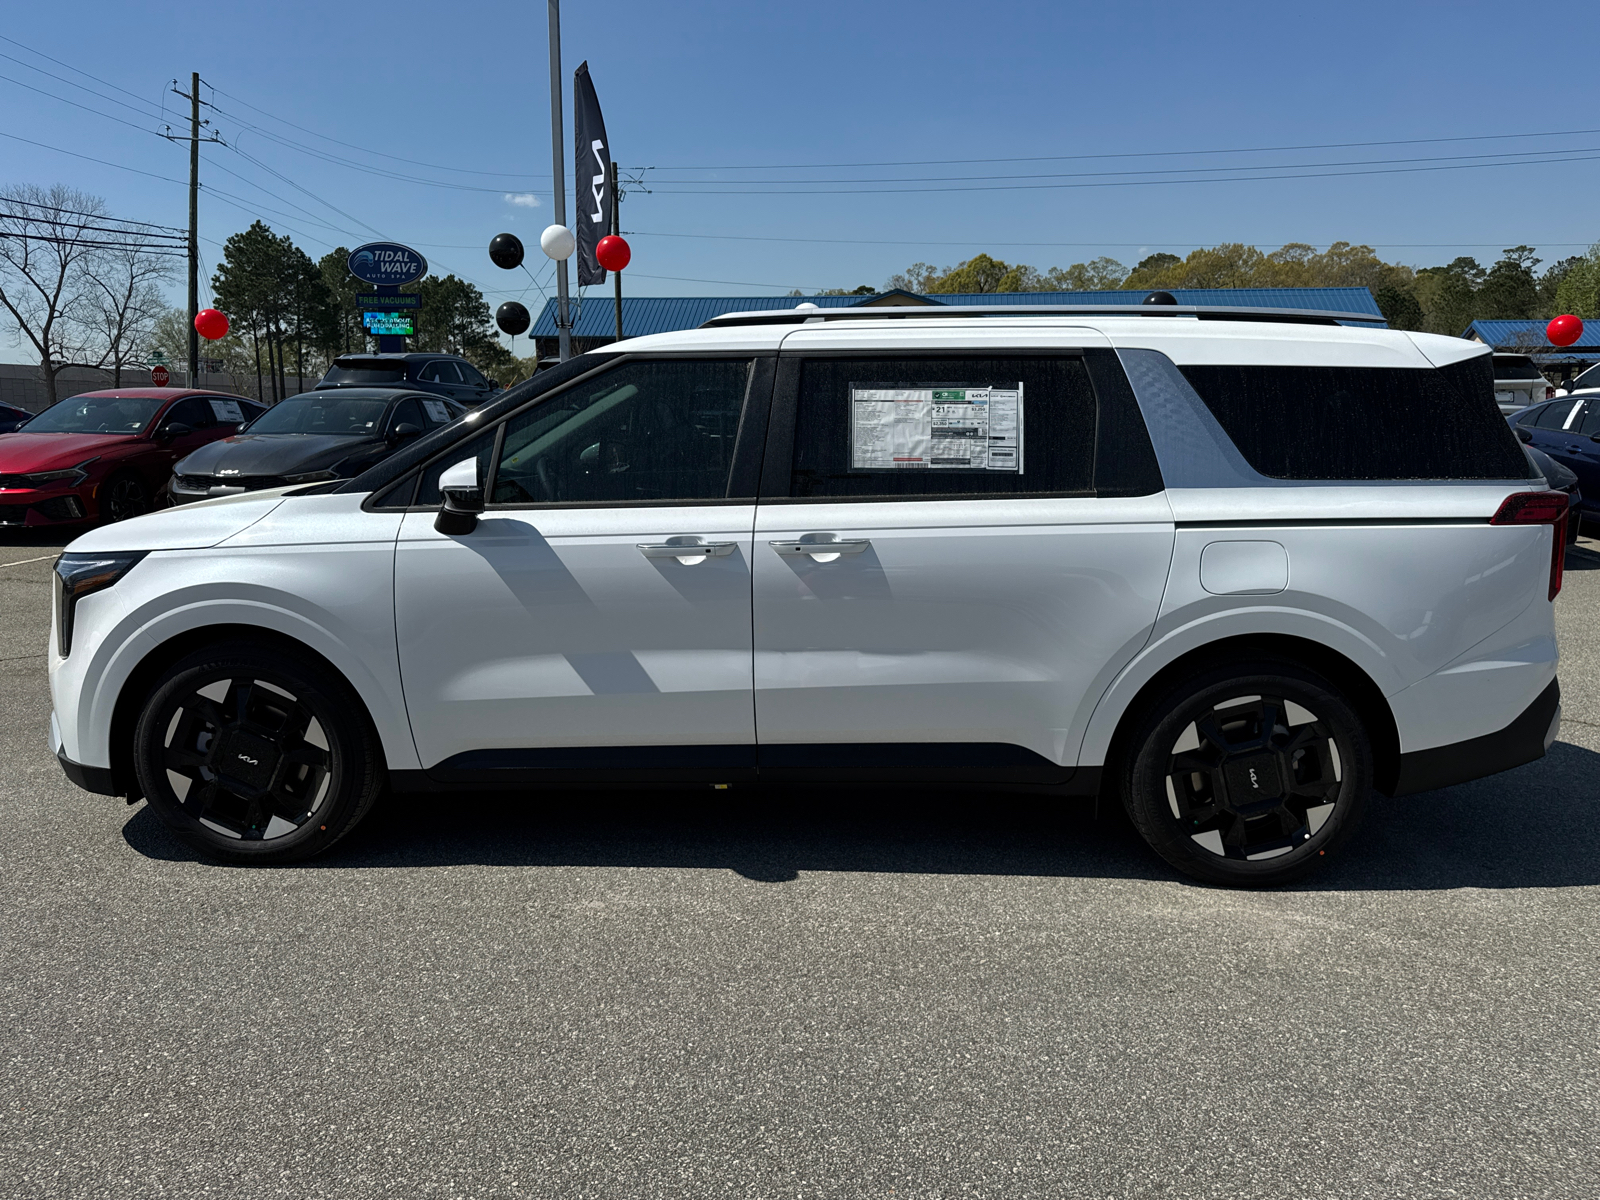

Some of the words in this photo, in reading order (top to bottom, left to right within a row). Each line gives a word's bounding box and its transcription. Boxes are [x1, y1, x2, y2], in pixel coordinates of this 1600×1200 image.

[591, 139, 605, 223] KIA
[374, 250, 410, 262] TIDAL
[380, 261, 418, 273] WAVE
[358, 296, 379, 304] FREE
[380, 296, 416, 305] VACUUMS
[152, 372, 169, 381] STOP
[237, 753, 259, 766] KIA
[1249, 768, 1259, 788] KIA
